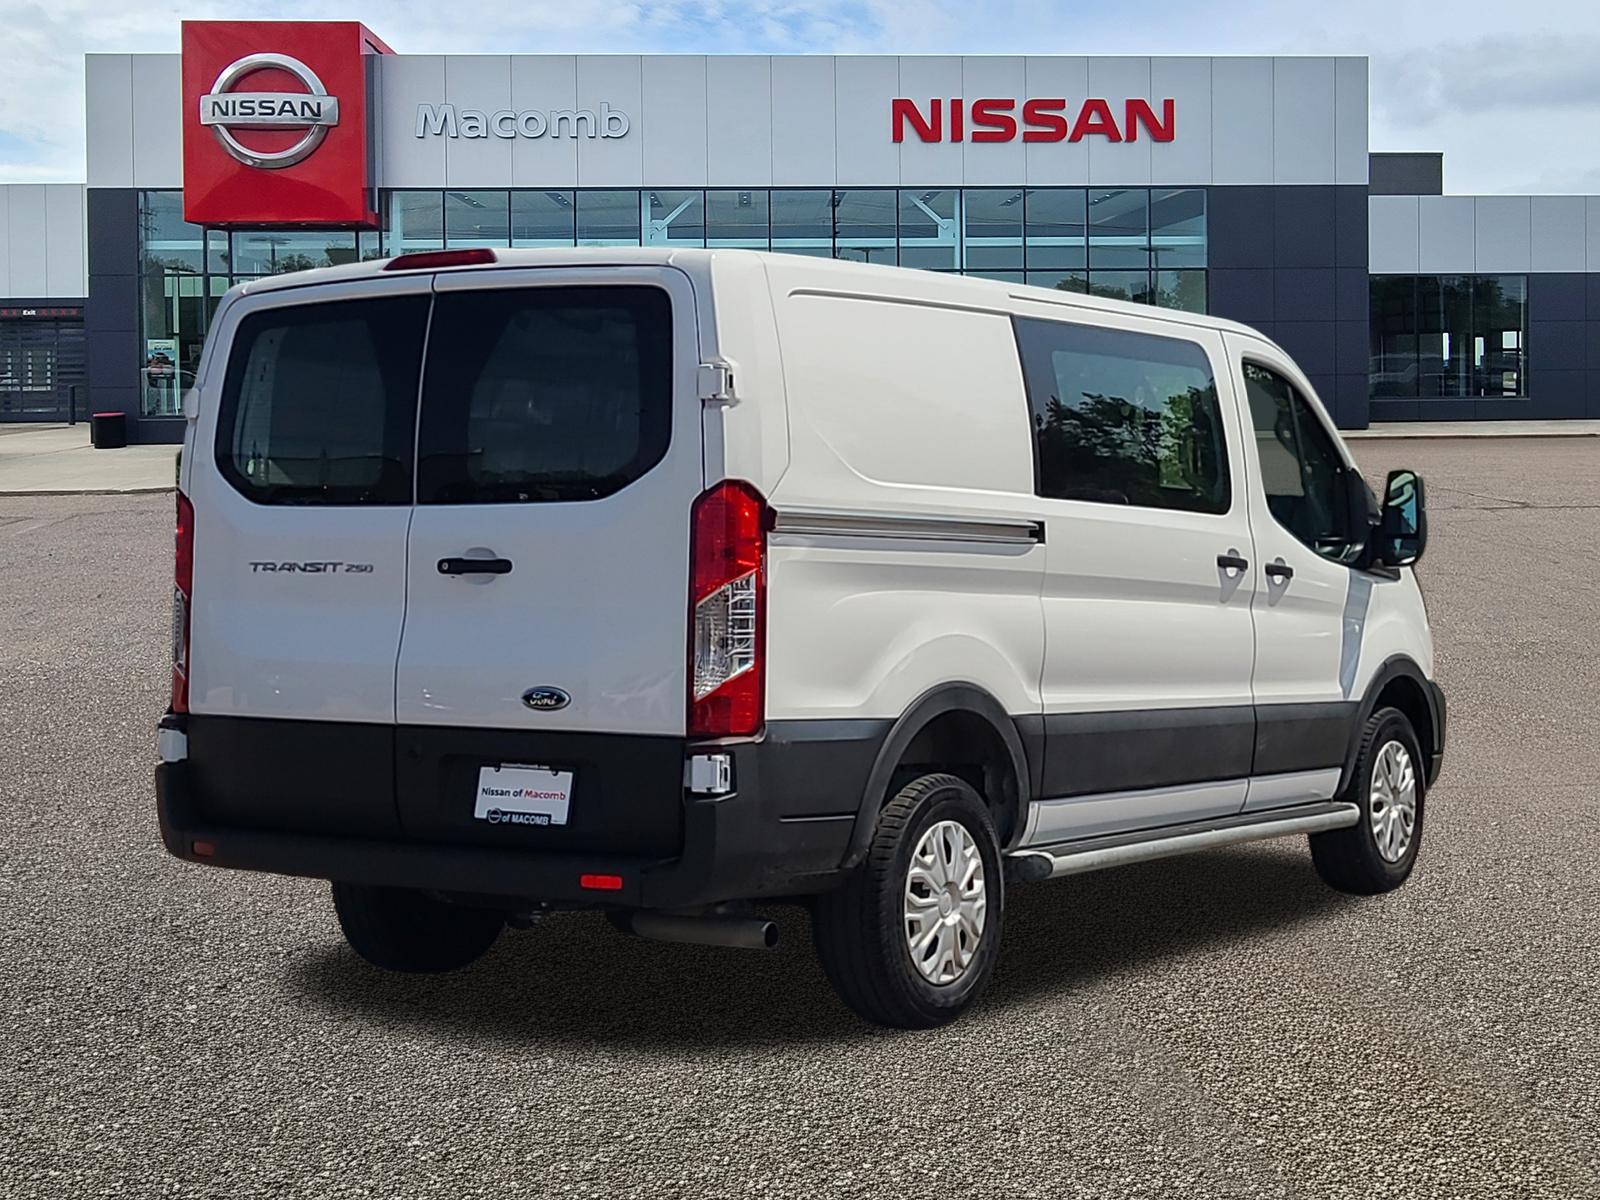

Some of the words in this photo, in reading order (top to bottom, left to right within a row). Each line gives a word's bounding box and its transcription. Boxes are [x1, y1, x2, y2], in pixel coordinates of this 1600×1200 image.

[211, 100, 322, 118] NISSAN
[415, 102, 630, 139] Macomb
[892, 98, 1175, 143] NISSAN
[249, 561, 344, 573] TRANSIT
[344, 563, 374, 573] 250
[481, 787, 511, 798] Nissan
[512, 788, 524, 798] of
[524, 789, 566, 801] Macomb
[501, 813, 511, 823] of
[511, 814, 549, 826] MACOMB
